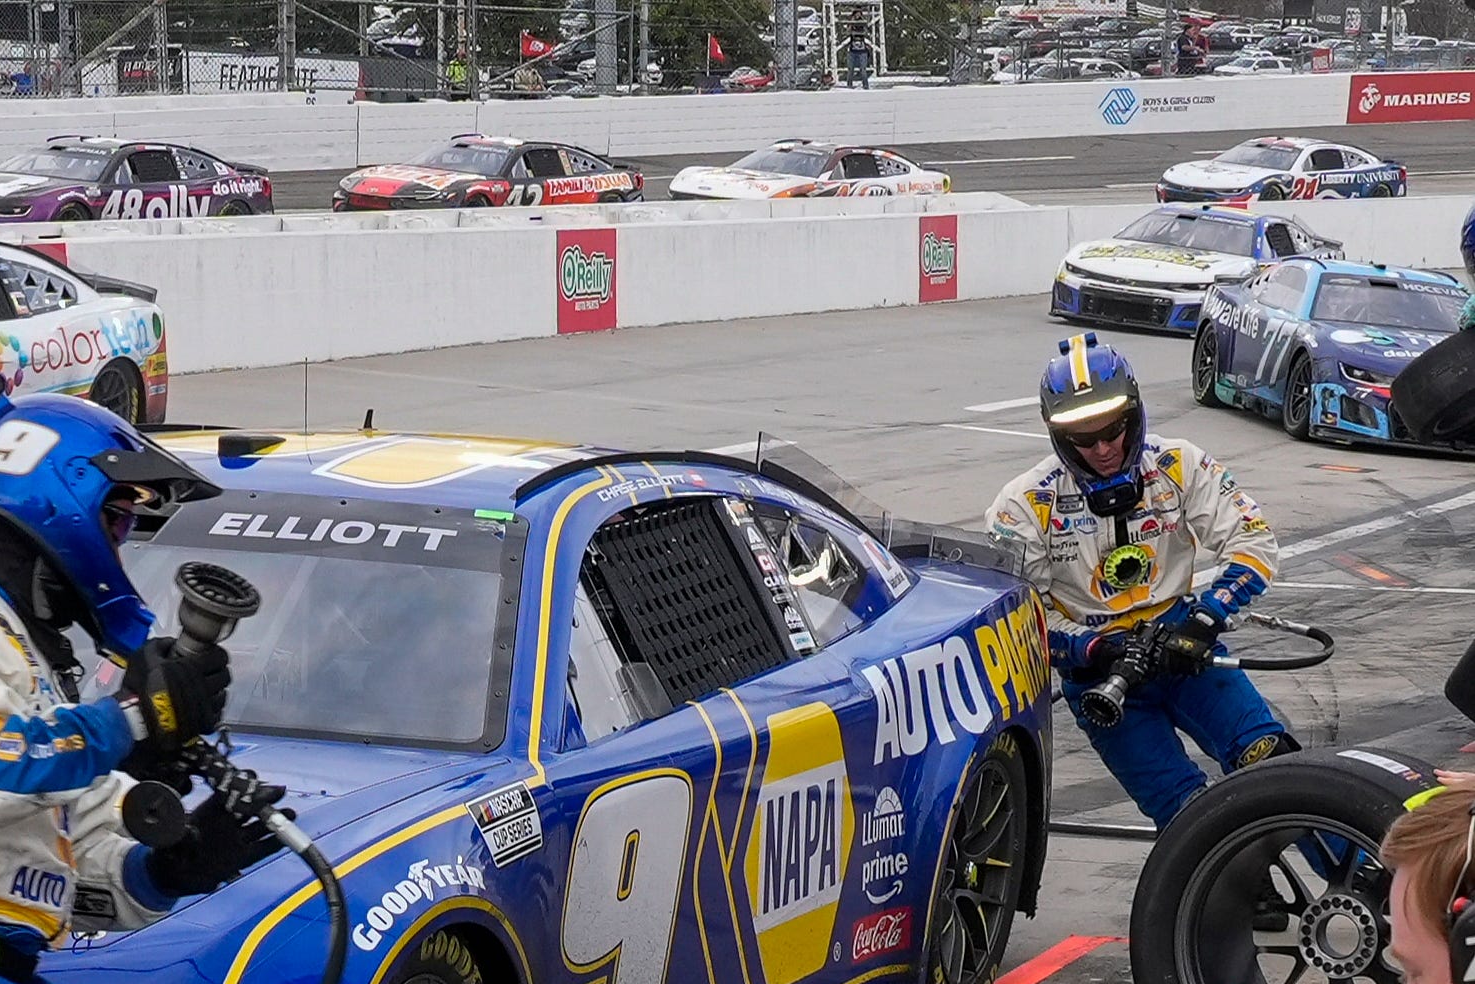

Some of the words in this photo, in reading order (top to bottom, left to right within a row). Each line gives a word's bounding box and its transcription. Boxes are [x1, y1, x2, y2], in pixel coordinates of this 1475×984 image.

[220, 64, 318, 92] FEATHEITE
[1142, 98, 1161, 106] BOYS
[1170, 96, 1191, 105] GIRLS
[1192, 96, 1215, 104] CLUBS
[1383, 91, 1472, 108] MARINES
[212, 181, 228, 195] do
[229, 180, 239, 193] it
[239, 180, 263, 197] right.
[1291, 178, 1319, 200] 24
[1321, 173, 1355, 185] LIBERTY
[1356, 171, 1400, 184] UNIVERSITY
[101, 188, 144, 220] 48
[145, 184, 211, 220] olly
[559, 245, 613, 303] O'Reilly
[922, 232, 955, 279] O'Reilly
[1239, 302, 1260, 340] Life
[1255, 317, 1299, 387] 77
[596, 480, 636, 502] CHASE
[635, 473, 686, 494] ELLIOTT
[208, 511, 459, 552] ELLIOTT
[861, 634, 994, 766] AUTO
[974, 592, 1048, 721] PARTS
[490, 788, 525, 817] NASCAR
[492, 825, 508, 850] CUP
[509, 816, 533, 845] SERIES
[762, 777, 842, 917] NAPA
[862, 810, 905, 847] LLumar
[7, 865, 67, 908] AUTO
[862, 850, 909, 892] prime
[352, 855, 486, 952] GOODYEAR
